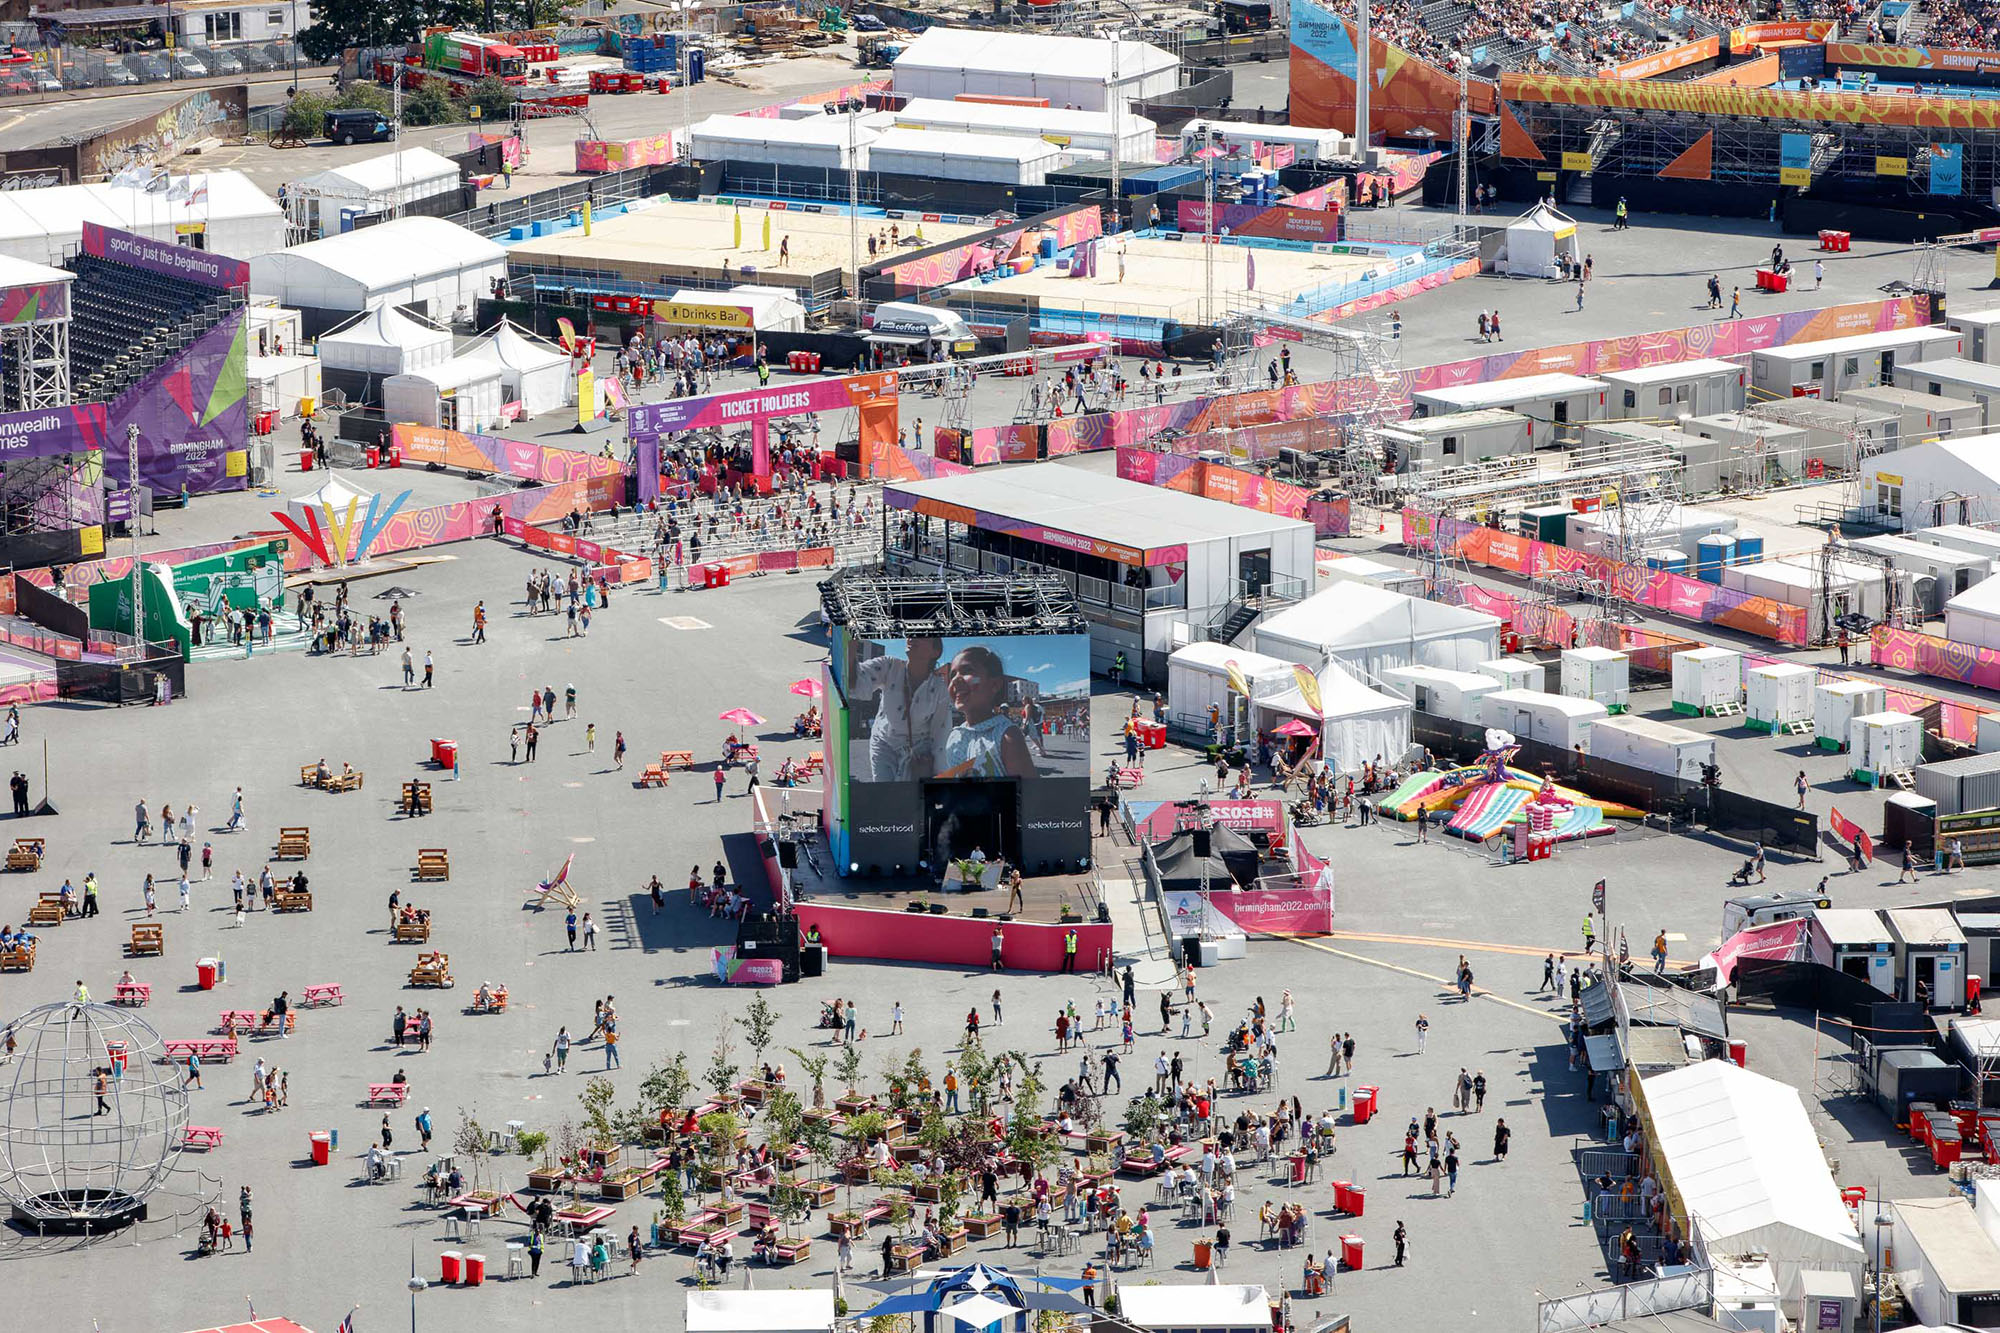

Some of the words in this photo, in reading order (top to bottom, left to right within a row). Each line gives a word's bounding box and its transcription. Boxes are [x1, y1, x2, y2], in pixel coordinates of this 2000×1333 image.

[1298, 20, 1341, 31] BIRMINGHAM
[1310, 29, 1328, 39] 2022
[110, 237, 134, 255] sport
[133, 241, 141, 256] is
[142, 247, 159, 263] just
[159, 249, 173, 265] the
[174, 252, 219, 278] beginning
[681, 307, 717, 322] Drinks
[718, 310, 739, 322] Bar
[720, 397, 760, 419] TICKET
[761, 391, 810, 414] HOLDERS
[170, 438, 223, 455] BIRMINGHAM
[185, 450, 207, 461] 2022
[1043, 530, 1078, 547] BIRMINGHAM
[1077, 539, 1092, 551] 2022
